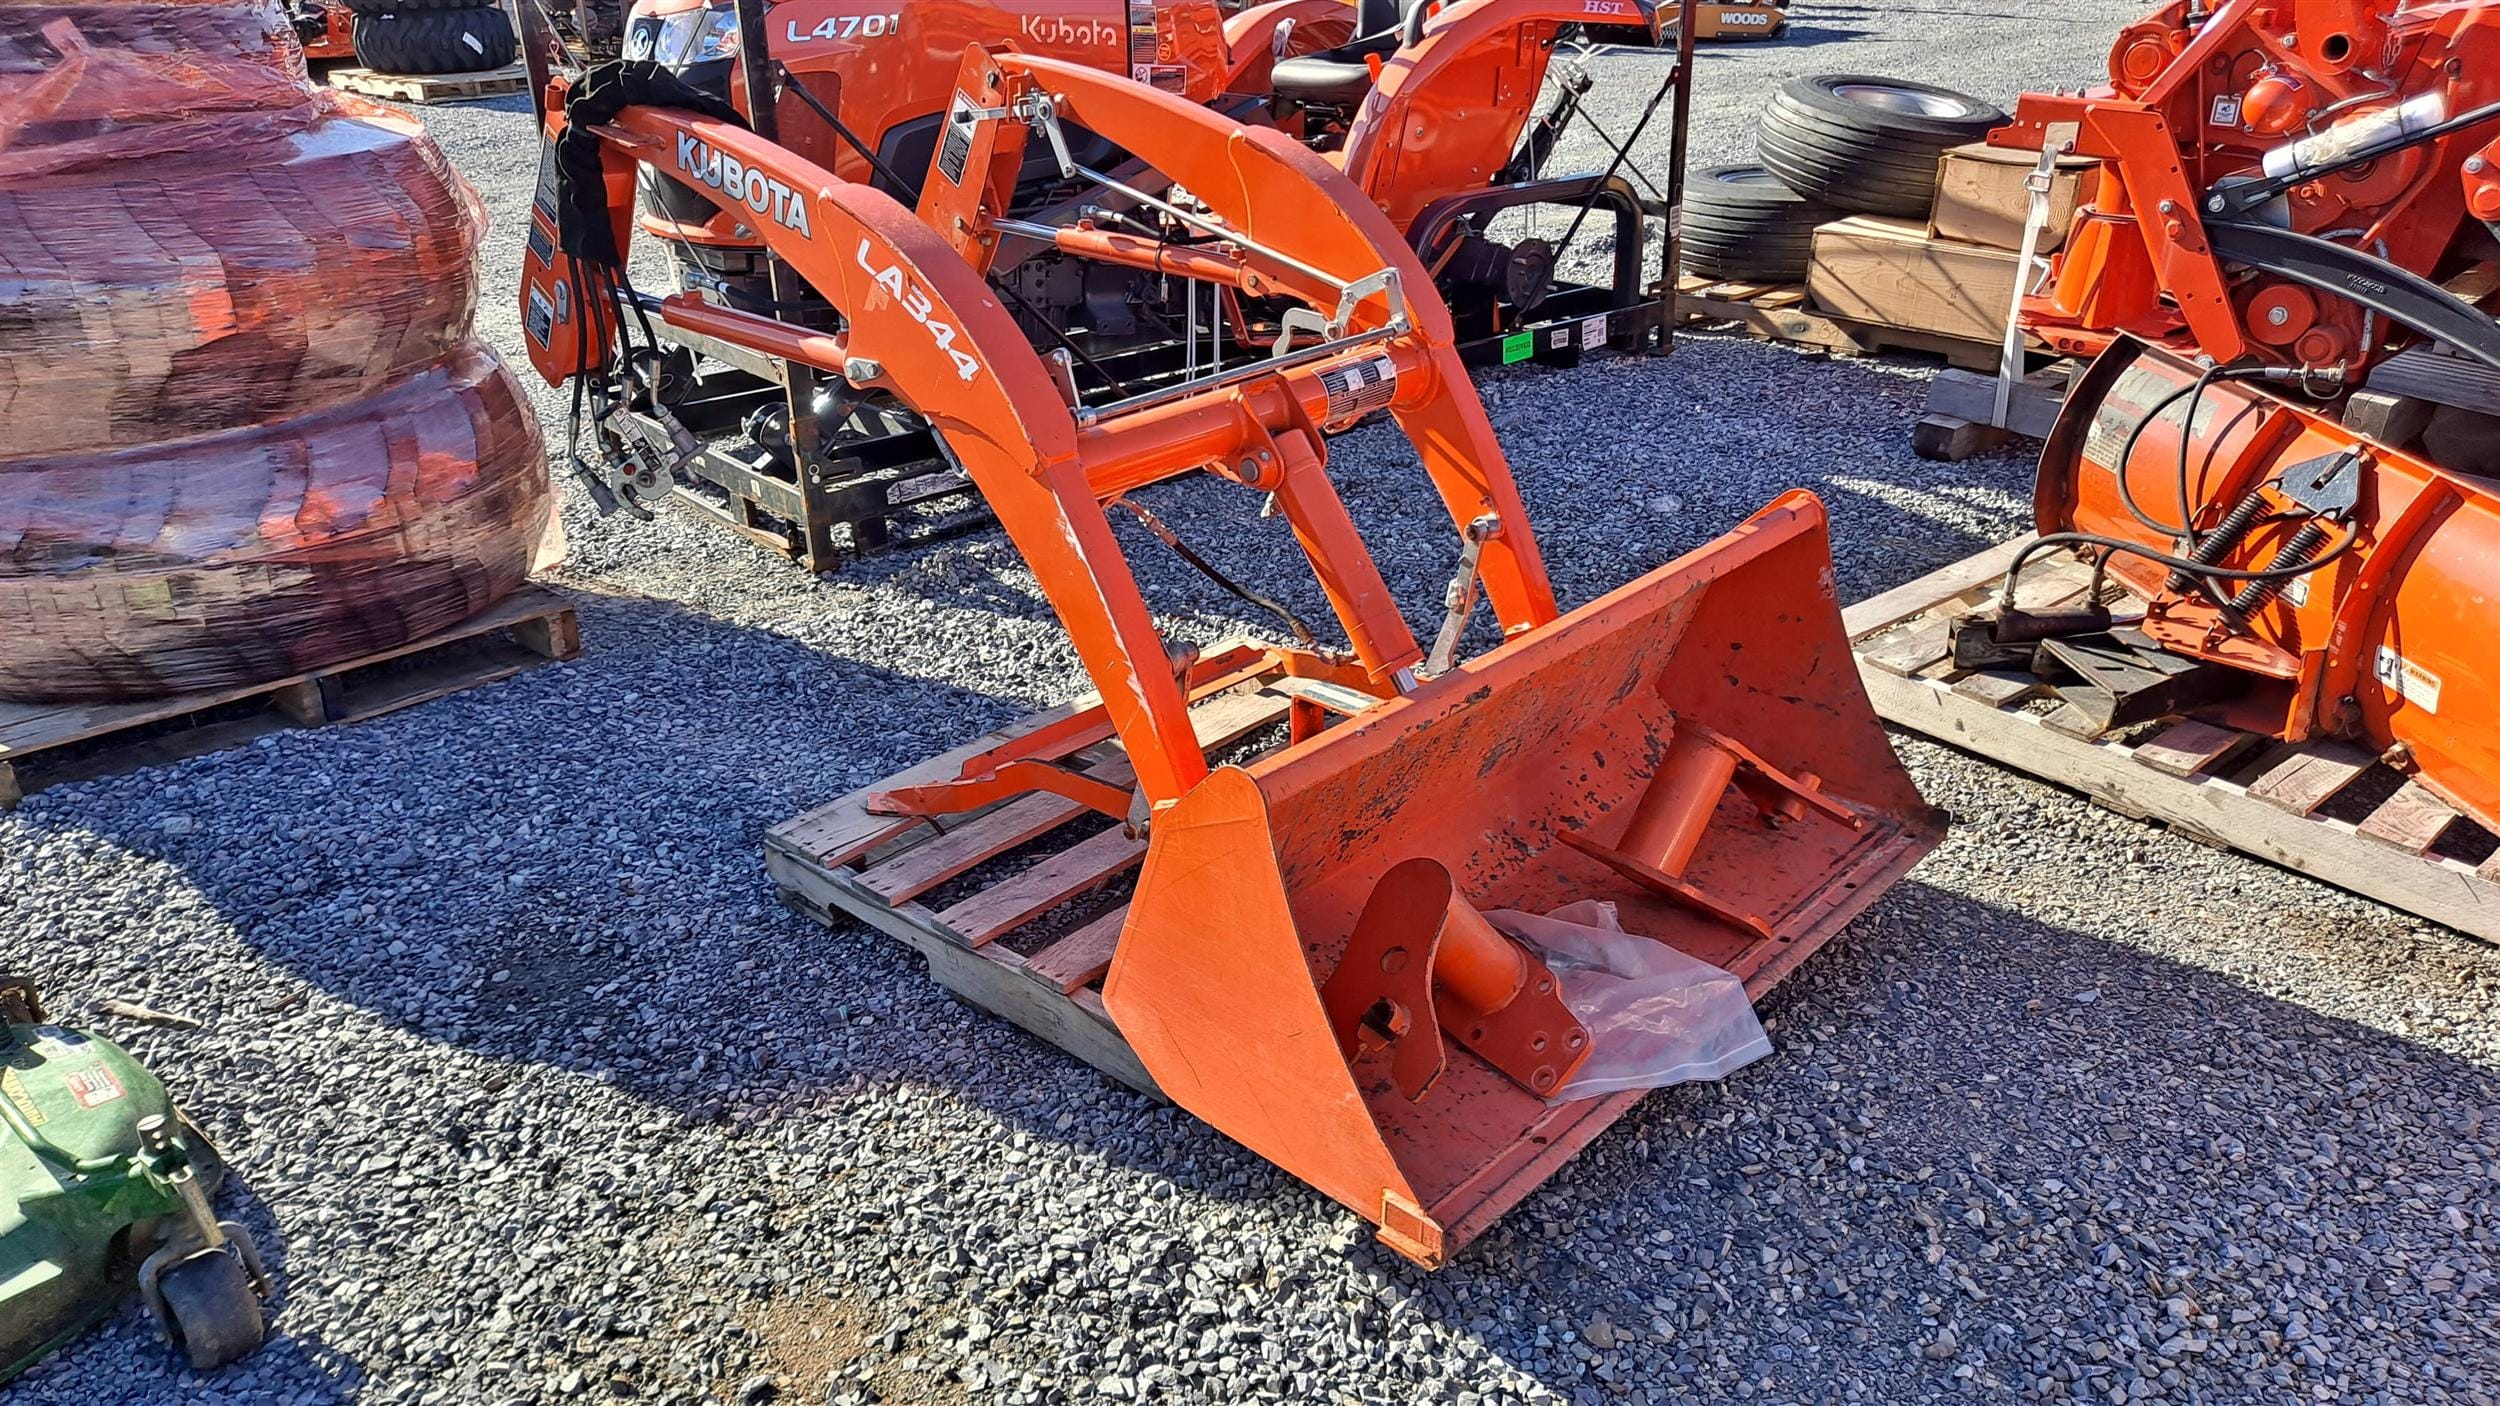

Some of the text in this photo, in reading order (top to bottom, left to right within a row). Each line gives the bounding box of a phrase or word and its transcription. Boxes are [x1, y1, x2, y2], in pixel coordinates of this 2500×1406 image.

[1583, 0, 1624, 14] HST
[1720, 12, 1768, 25] WOODS
[785, 13, 900, 42] L4701
[1020, 14, 1117, 46] Kubota
[676, 129, 812, 240] KUBOTA
[855, 239, 982, 381] LA344
